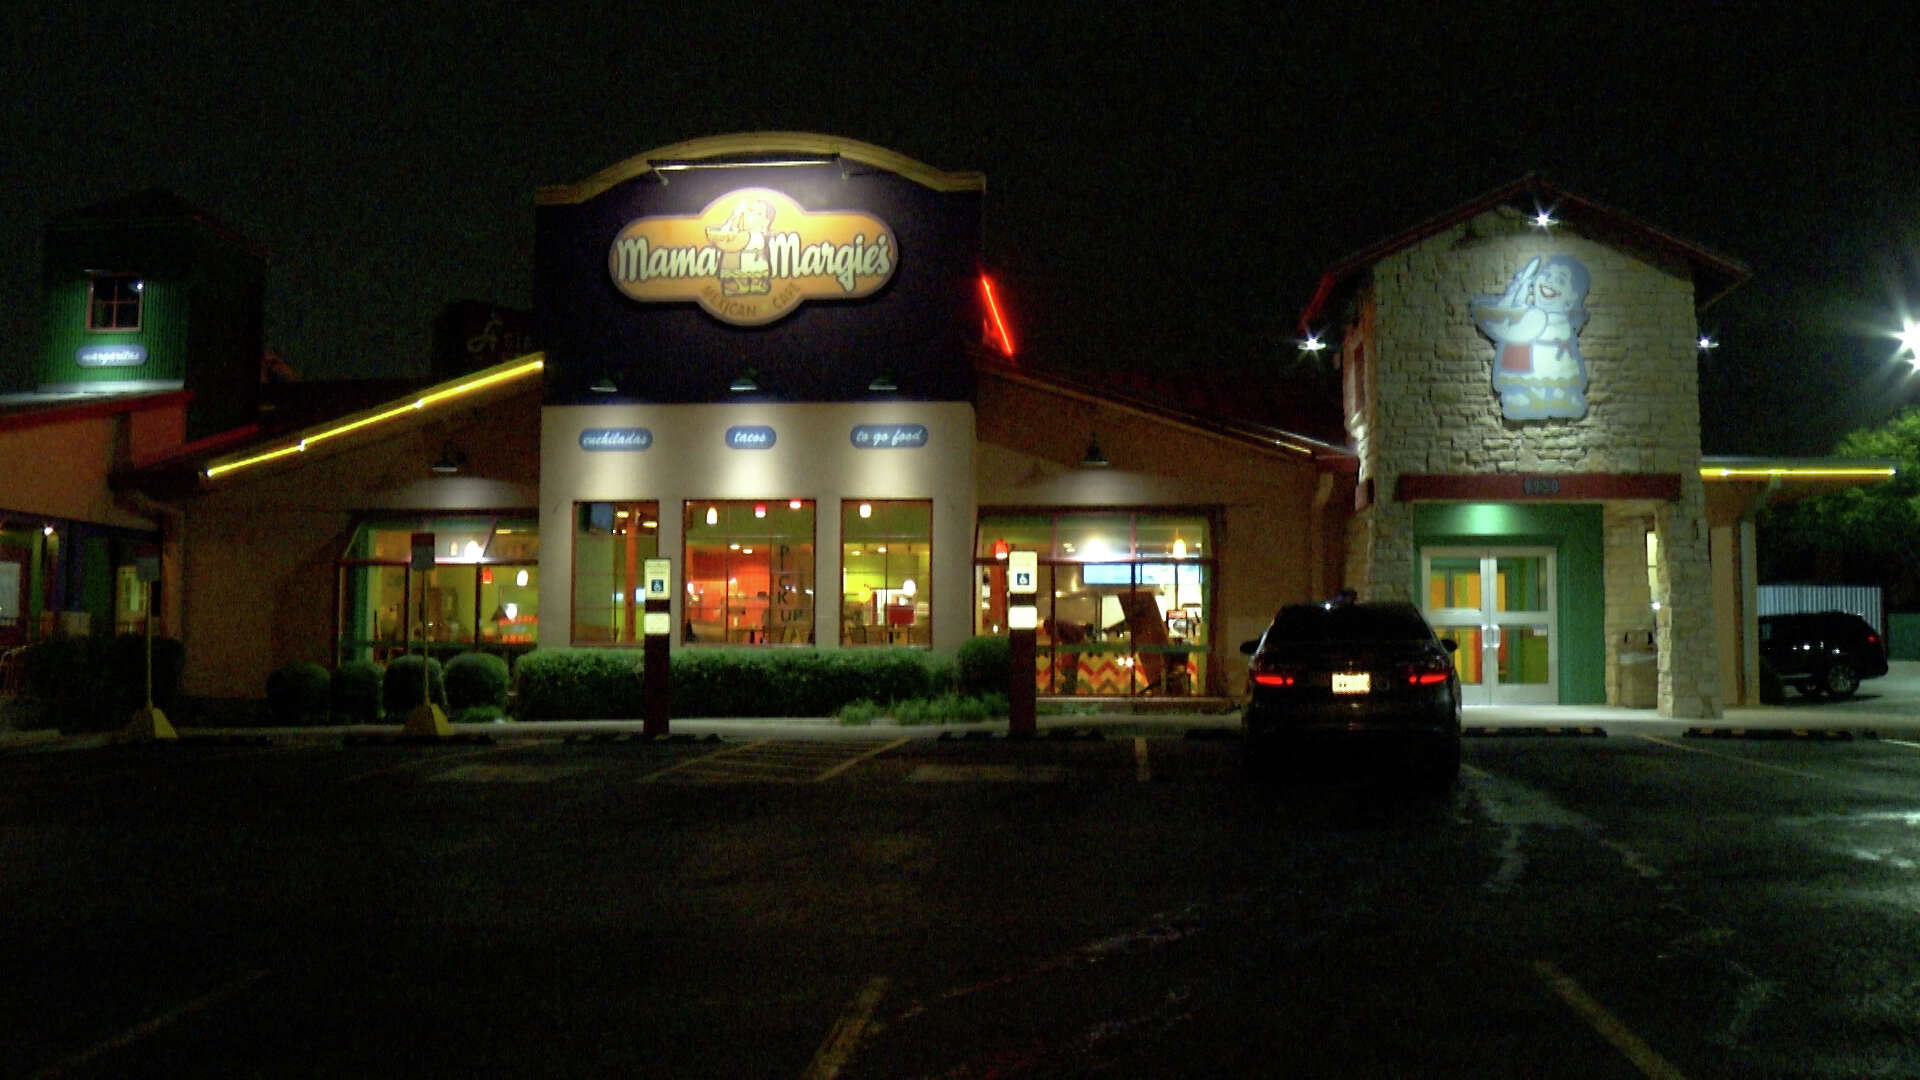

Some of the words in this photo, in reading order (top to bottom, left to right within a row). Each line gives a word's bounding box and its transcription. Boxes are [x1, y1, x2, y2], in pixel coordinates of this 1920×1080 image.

[616, 236, 720, 282] Mama
[583, 431, 648, 446] enchiladas
[734, 431, 766, 444] tacos
[856, 430, 869, 442] to
[873, 432, 888, 446] go
[891, 428, 923, 446] food
